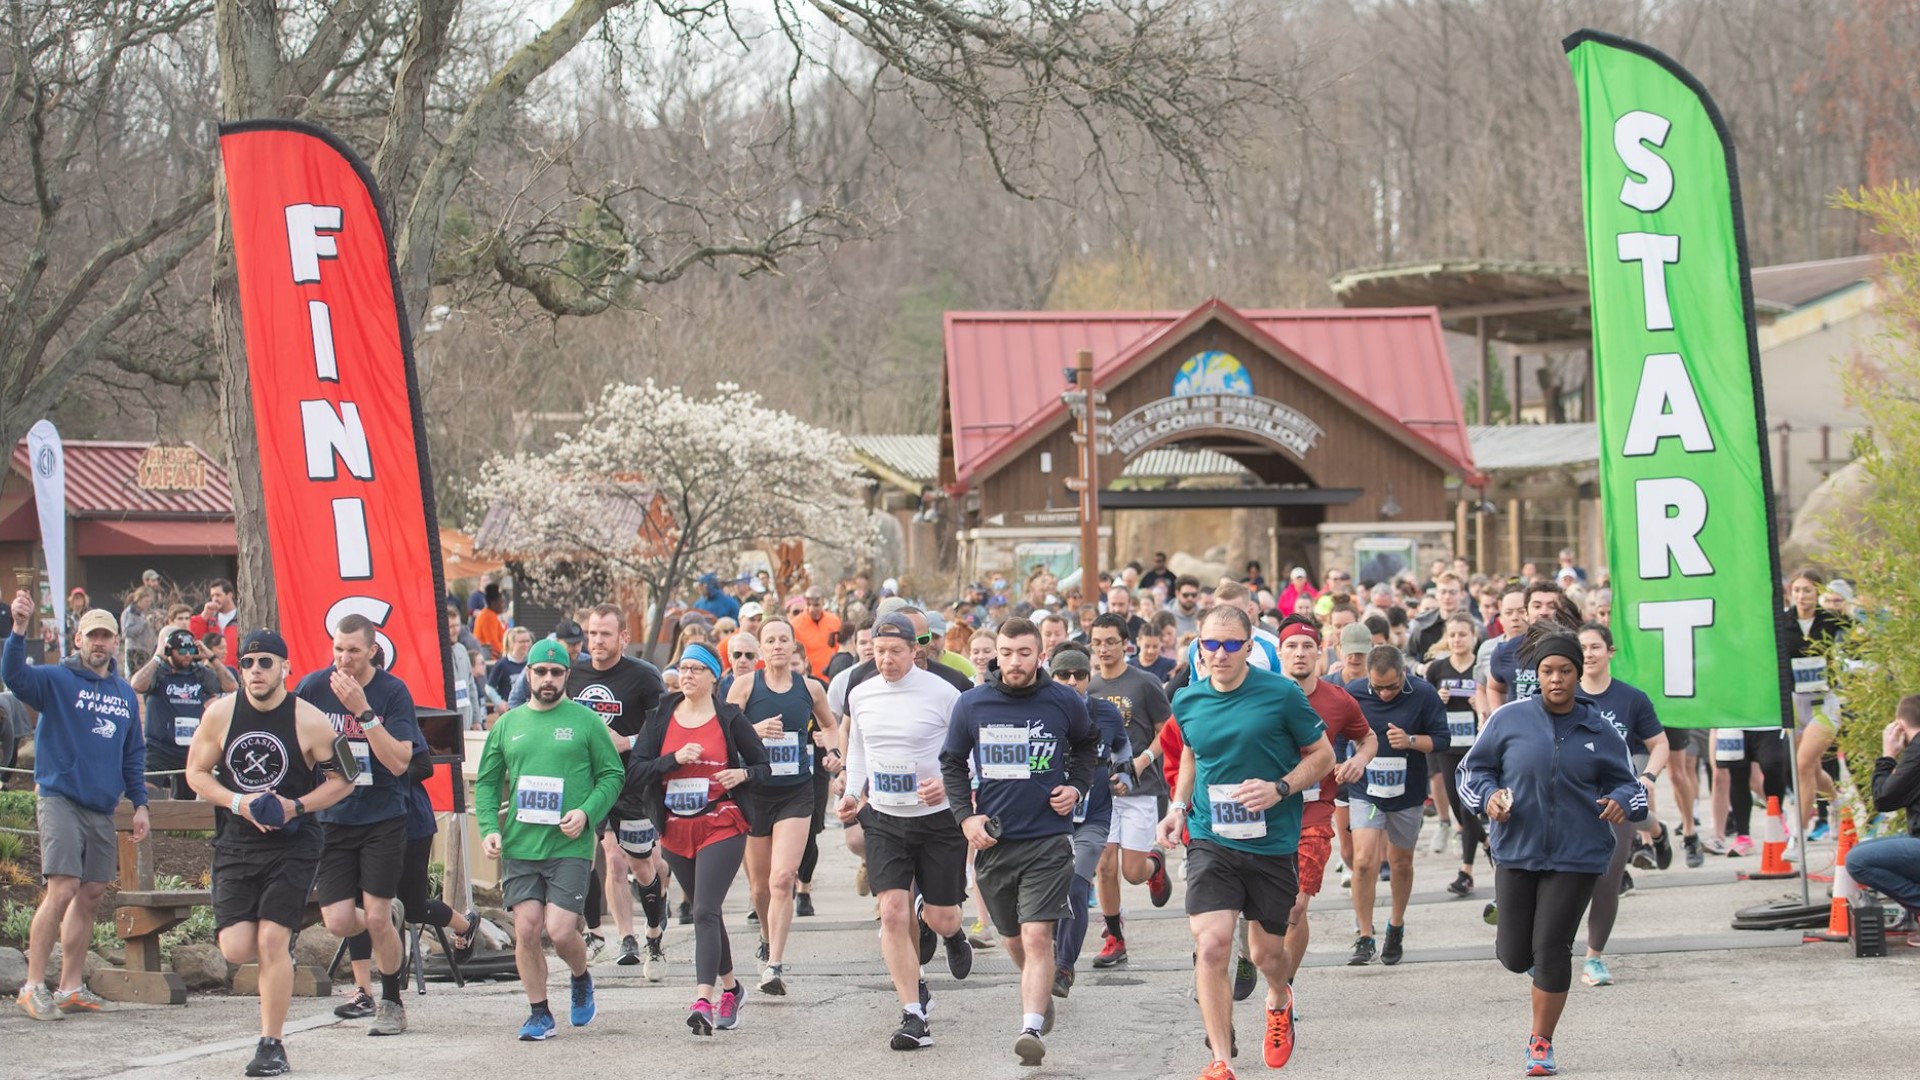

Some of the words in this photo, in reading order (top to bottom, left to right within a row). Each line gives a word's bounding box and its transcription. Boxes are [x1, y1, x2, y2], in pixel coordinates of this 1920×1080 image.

[1612, 109, 1716, 698] START
[283, 202, 398, 671] FINIS
[1118, 411, 1216, 455] WELCOME
[1222, 412, 1309, 453] PAVILION
[138, 460, 205, 490] SAFARI
[78, 689, 101, 701] RUN
[103, 694, 128, 707] WITH
[596, 703, 619, 713] OCR
[75, 699, 85, 709] A
[87, 701, 130, 719] PURPOSE
[1449, 722, 1472, 736] 495
[240, 738, 277, 752] OCASIO
[982, 744, 1027, 764] 1650
[1029, 756, 1053, 770] 5K
[874, 773, 914, 793] 1350
[1370, 770, 1403, 786] 1587
[520, 790, 560, 811] 1458
